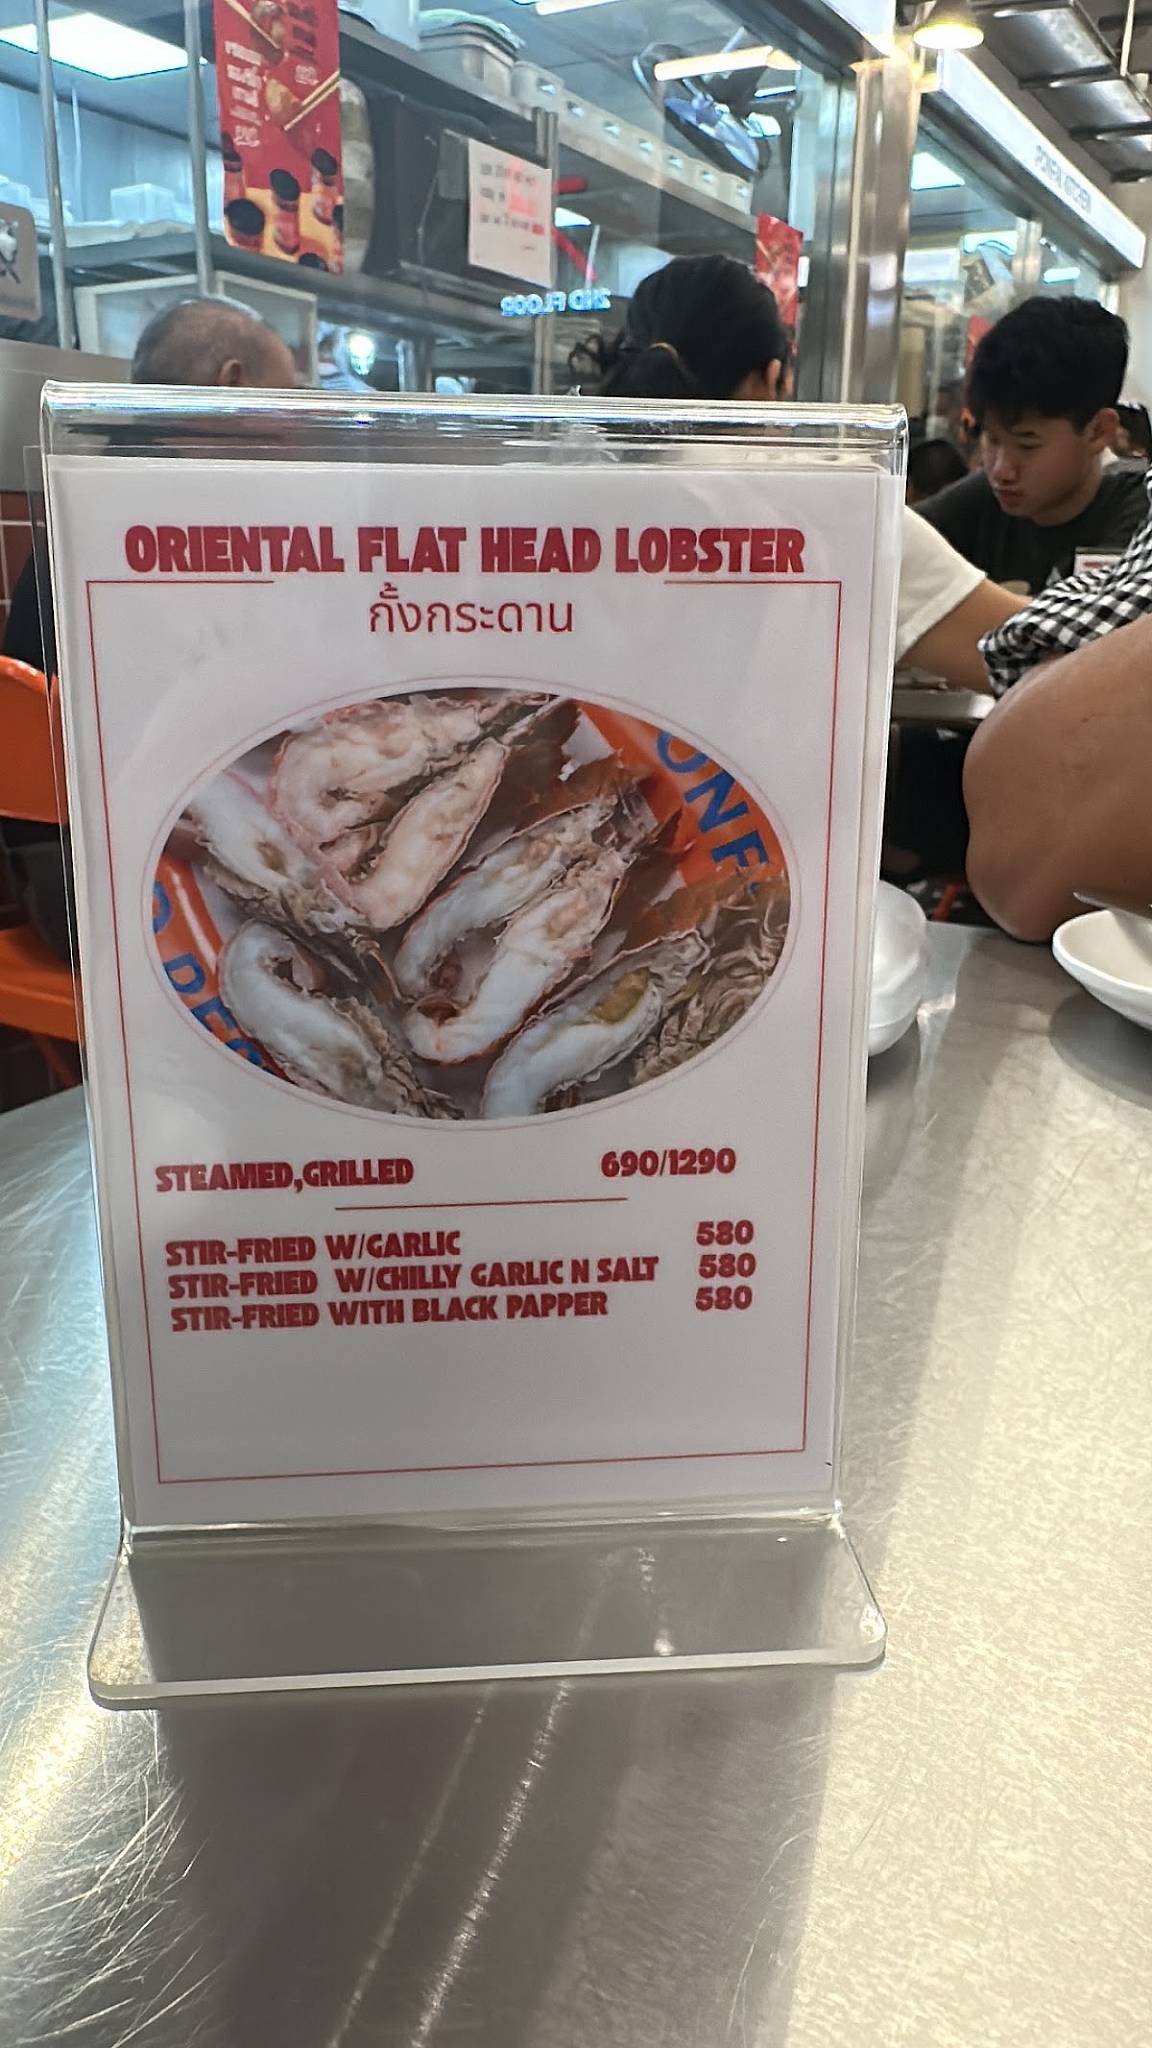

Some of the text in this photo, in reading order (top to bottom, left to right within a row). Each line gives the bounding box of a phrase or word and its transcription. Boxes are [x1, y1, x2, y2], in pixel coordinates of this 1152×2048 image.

[124, 526, 806, 576] ORIENTAL FLAT HEAD LOBSTER
[369, 582, 574, 633] กั้งกระดาน
[601, 1147, 737, 1178] 690/1290
[165, 1220, 755, 1267] STIR-FRIED W/GARLIC 580
[168, 1252, 756, 1300] STIR-FRIED W/CHILLY GARLIC N SALT 580
[170, 1284, 753, 1332] STIR-FRIED WITH BLACK PAPPER 580
